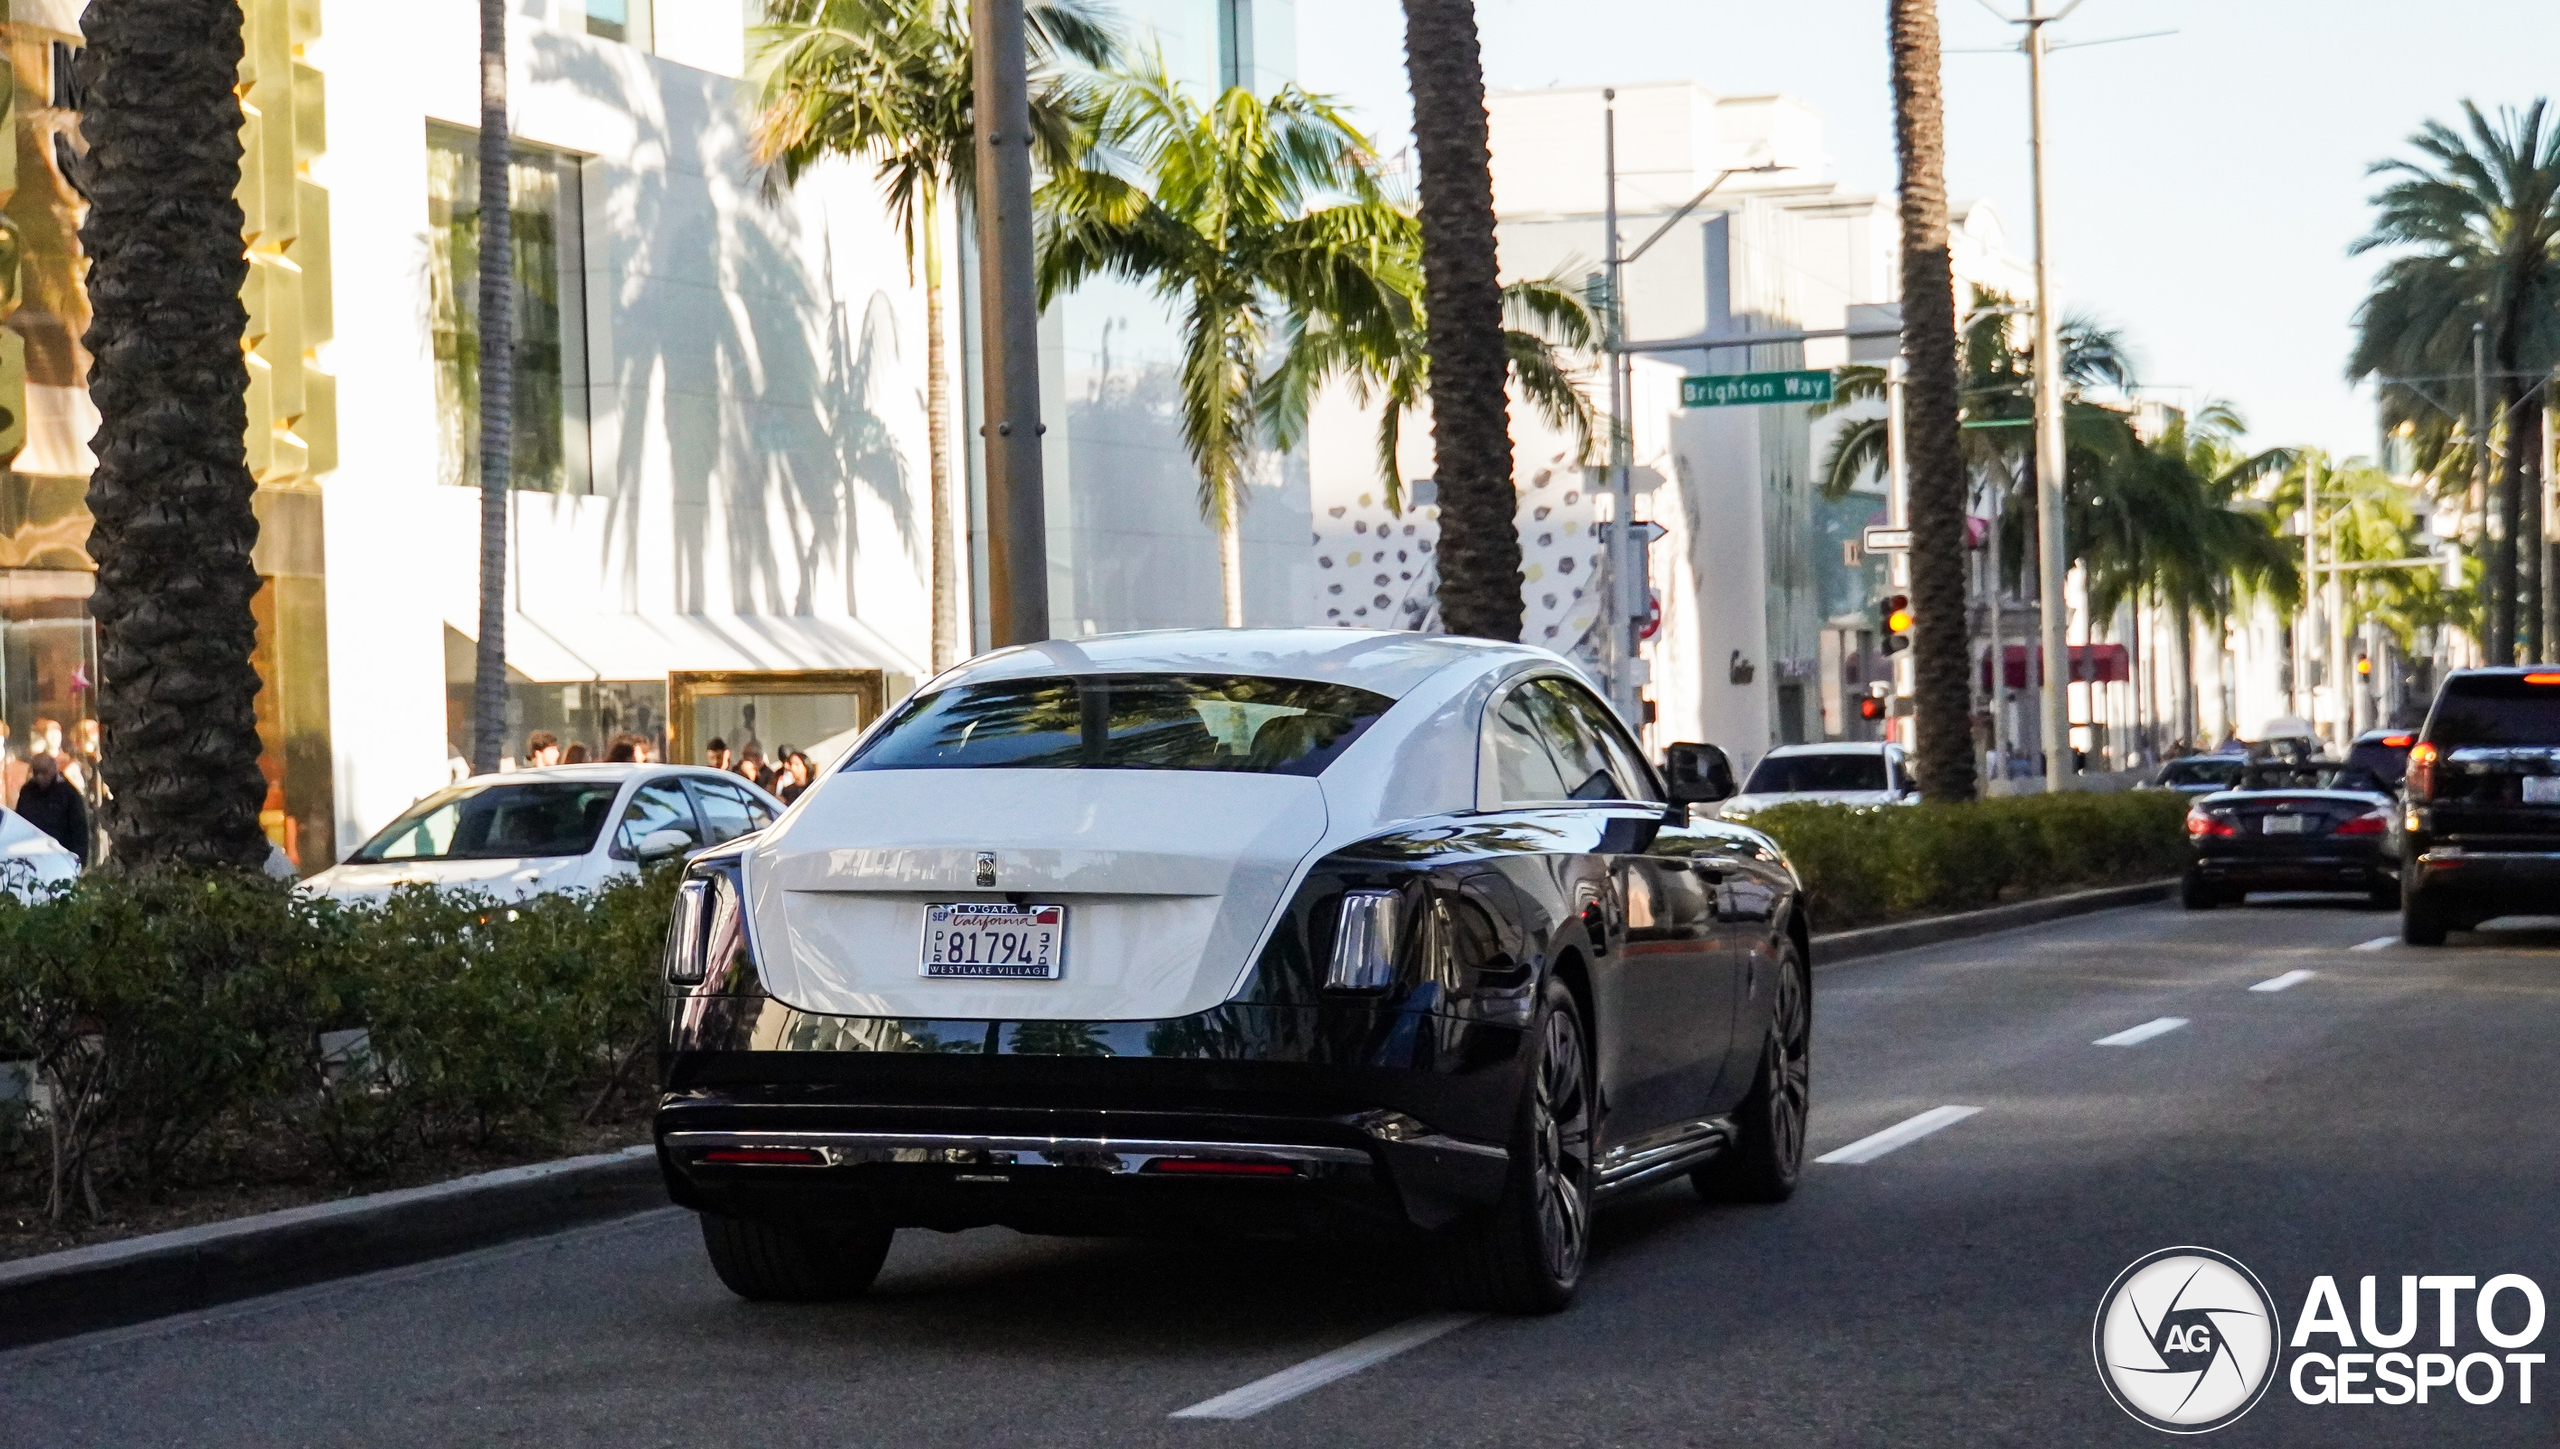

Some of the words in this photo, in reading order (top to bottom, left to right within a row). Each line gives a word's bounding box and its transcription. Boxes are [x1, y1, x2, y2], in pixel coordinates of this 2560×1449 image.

[1684, 381, 1774, 405] Brighton
[1784, 377, 1823, 398] Way
[968, 905, 1019, 914] O'GARA
[932, 911, 948, 922] SEP
[952, 915, 1037, 931] California
[947, 932, 1033, 964] 81794
[930, 966, 991, 975] WESTLAKE
[997, 966, 1048, 976] VILLAGE
